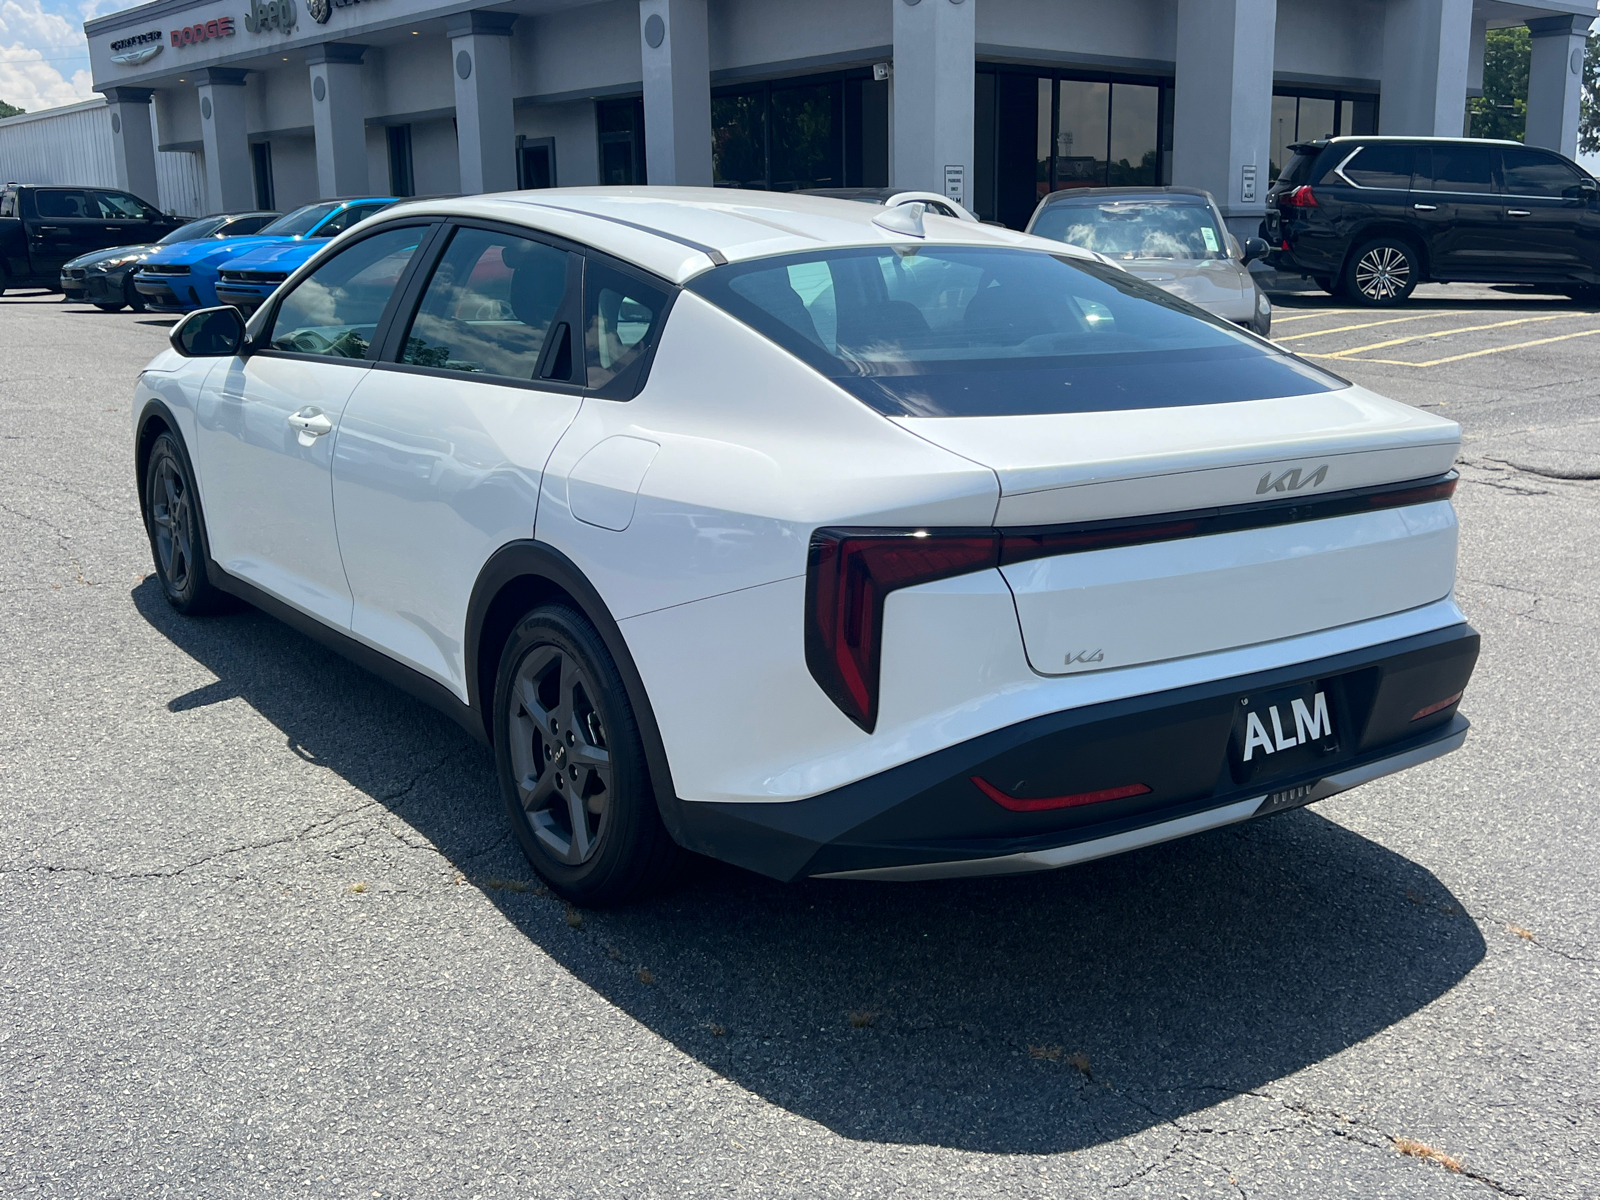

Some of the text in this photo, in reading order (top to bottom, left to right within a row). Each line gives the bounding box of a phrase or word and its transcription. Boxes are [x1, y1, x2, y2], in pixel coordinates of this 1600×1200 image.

[170, 16, 235, 48] DODGE
[245, 0, 297, 35] Jeep
[1064, 648, 1104, 665] K4
[1243, 691, 1332, 762] ALM
